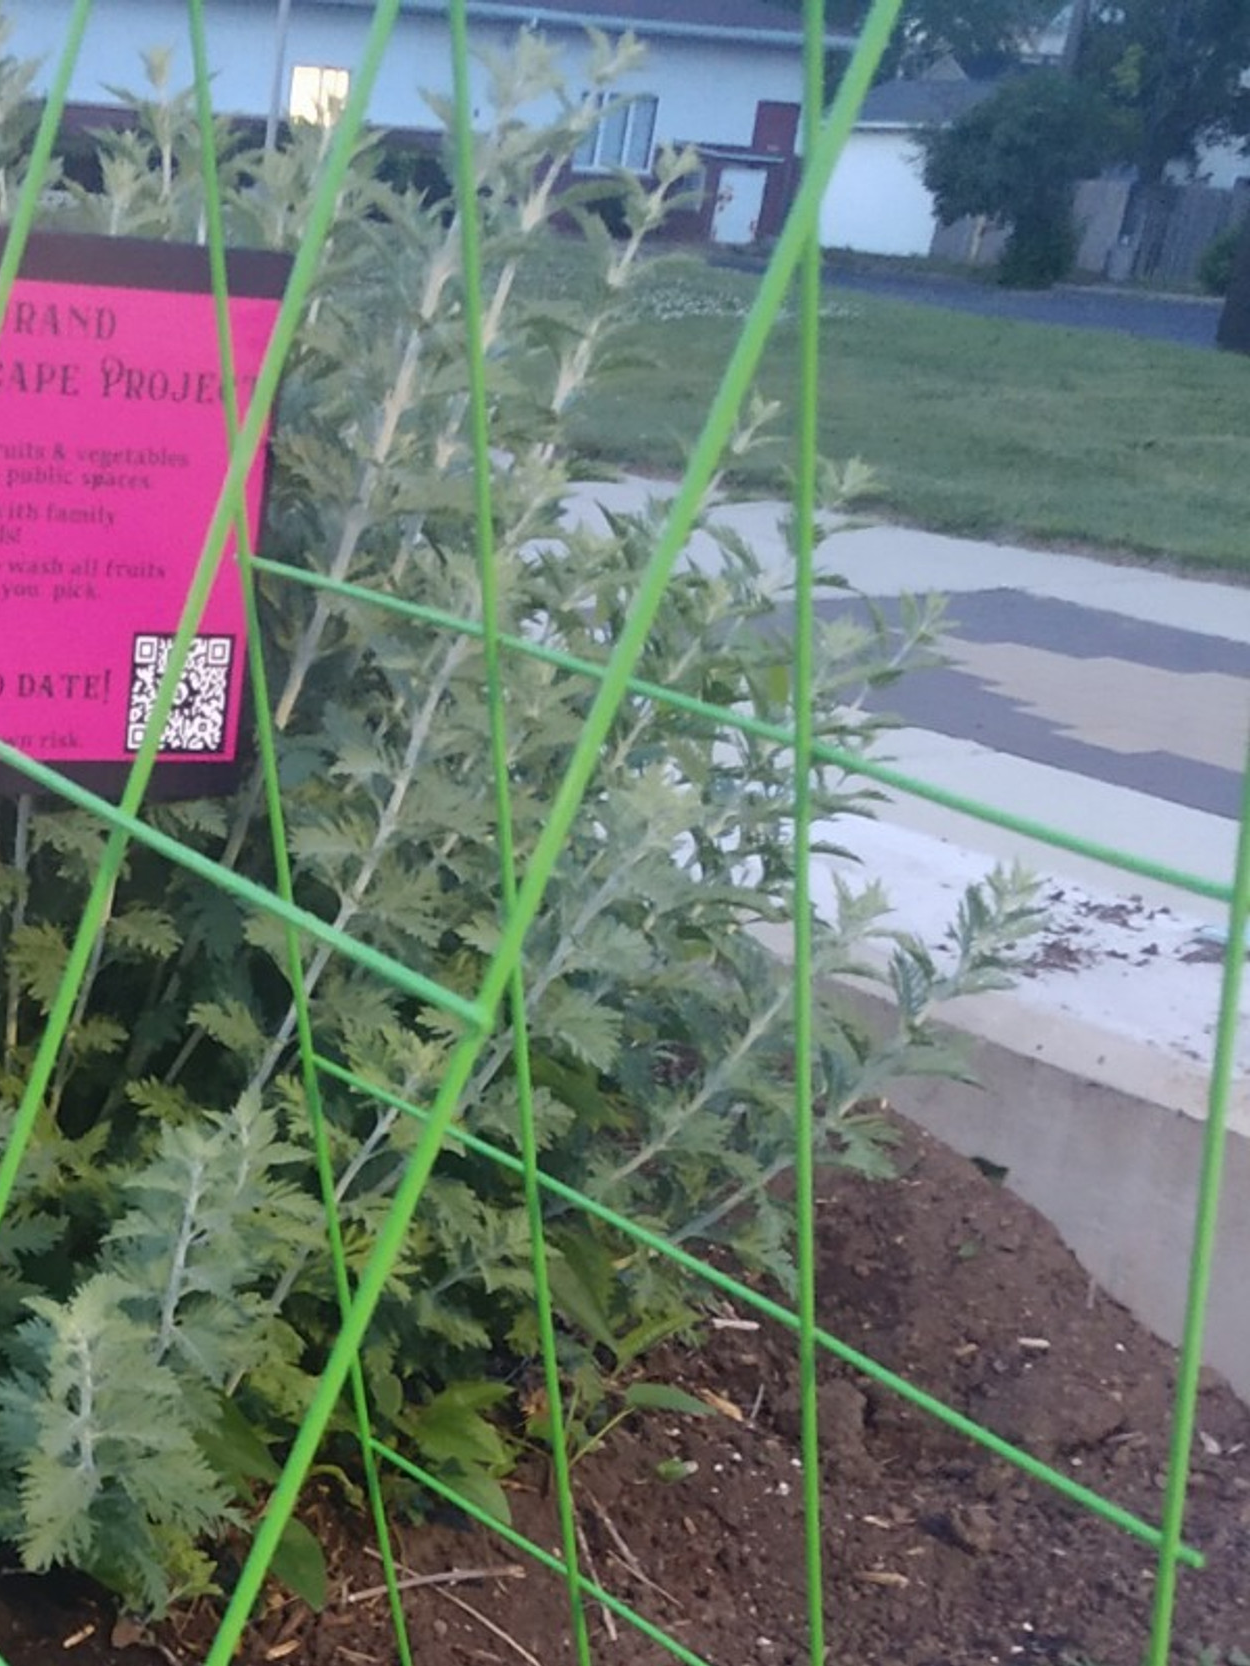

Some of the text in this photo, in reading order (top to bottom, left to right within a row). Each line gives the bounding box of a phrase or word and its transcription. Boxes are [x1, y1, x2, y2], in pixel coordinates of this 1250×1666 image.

[53, 443, 67, 462] &
[78, 446, 188, 469] vegetables
[5, 468, 72, 488] public
[46, 502, 115, 528] family
[8, 557, 63, 575] wash
[71, 558, 97, 578] all
[106, 559, 166, 580] fruits
[1, 582, 39, 603] you
[18, 668, 112, 704] DATE!
